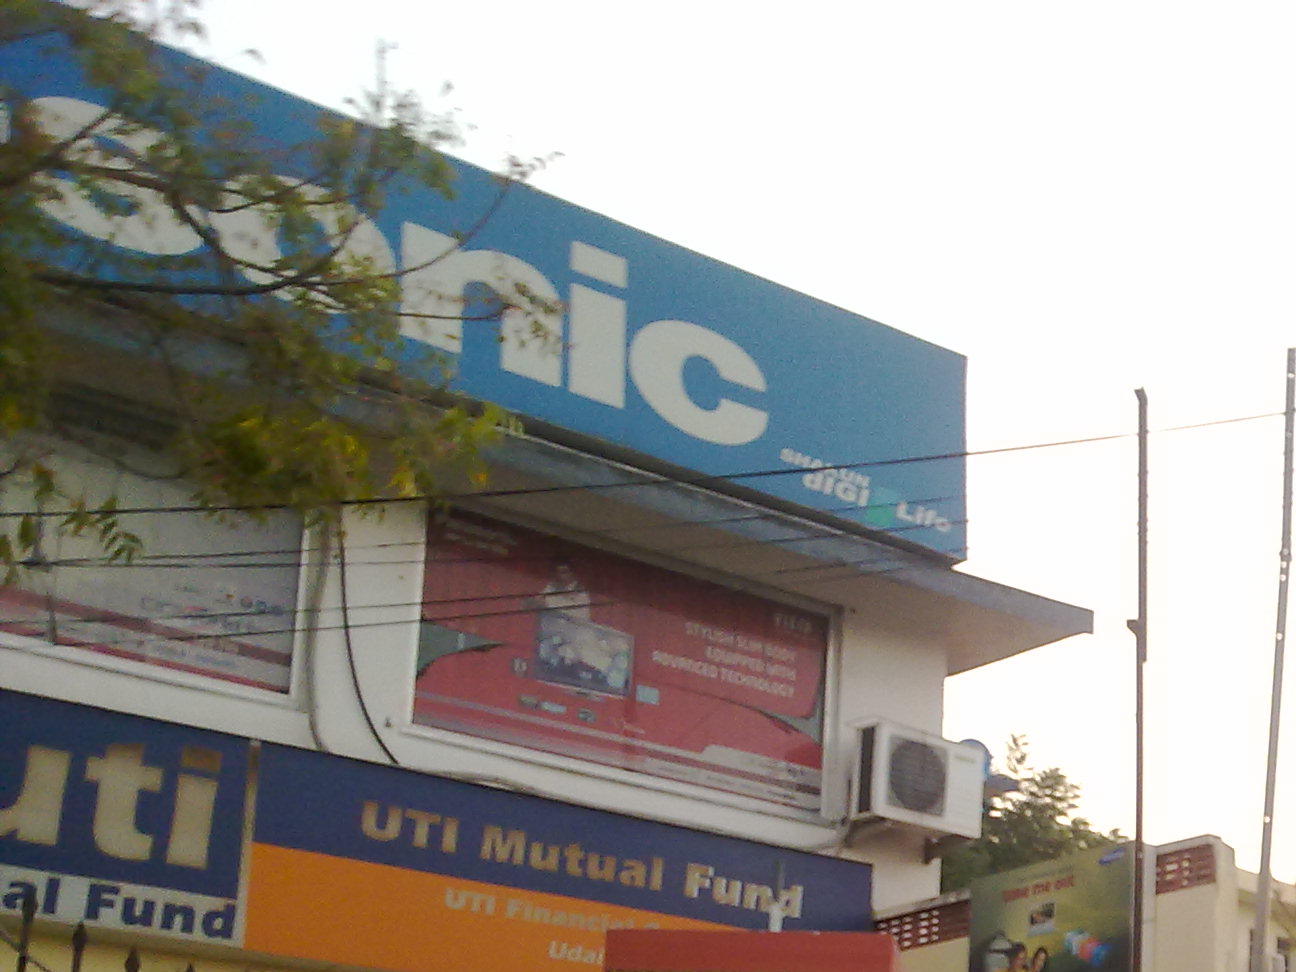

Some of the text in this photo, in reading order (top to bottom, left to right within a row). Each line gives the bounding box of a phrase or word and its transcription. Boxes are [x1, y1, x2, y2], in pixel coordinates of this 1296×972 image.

[0, 96, 768, 446] sonic
[361, 801, 804, 919] UTI Mutual Fund
[444, 887, 497, 917] UTI
[84, 883, 237, 940] Fund
